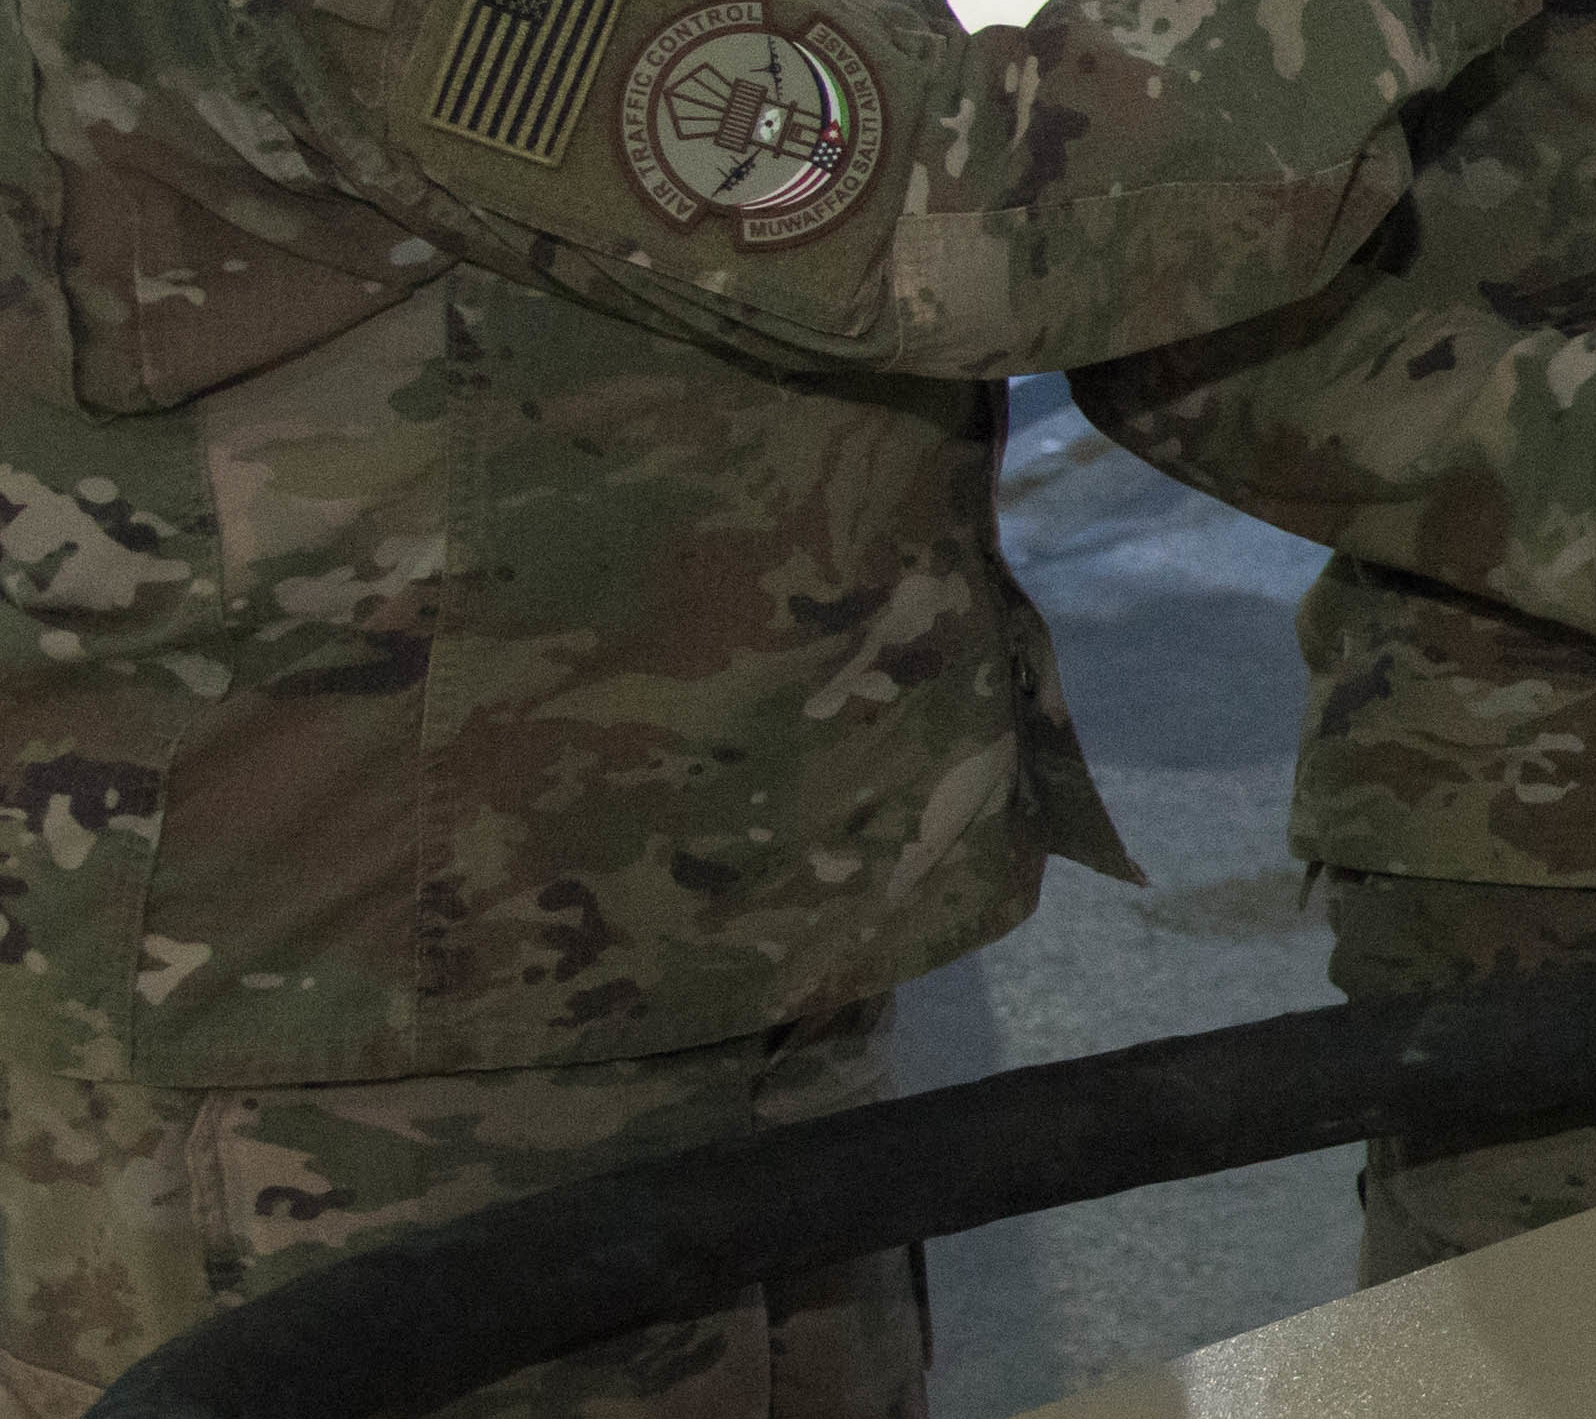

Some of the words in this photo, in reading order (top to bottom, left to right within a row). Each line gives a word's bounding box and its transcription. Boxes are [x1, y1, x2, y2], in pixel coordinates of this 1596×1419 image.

[645, 2, 762, 66] CONTROL
[811, 29, 859, 75] BASE
[852, 75, 879, 113] AIR
[624, 71, 657, 178] TRAFFIC
[852, 115, 880, 172] SALTI
[652, 179, 695, 217] AIR
[748, 175, 861, 238] MUWAFFAQ
